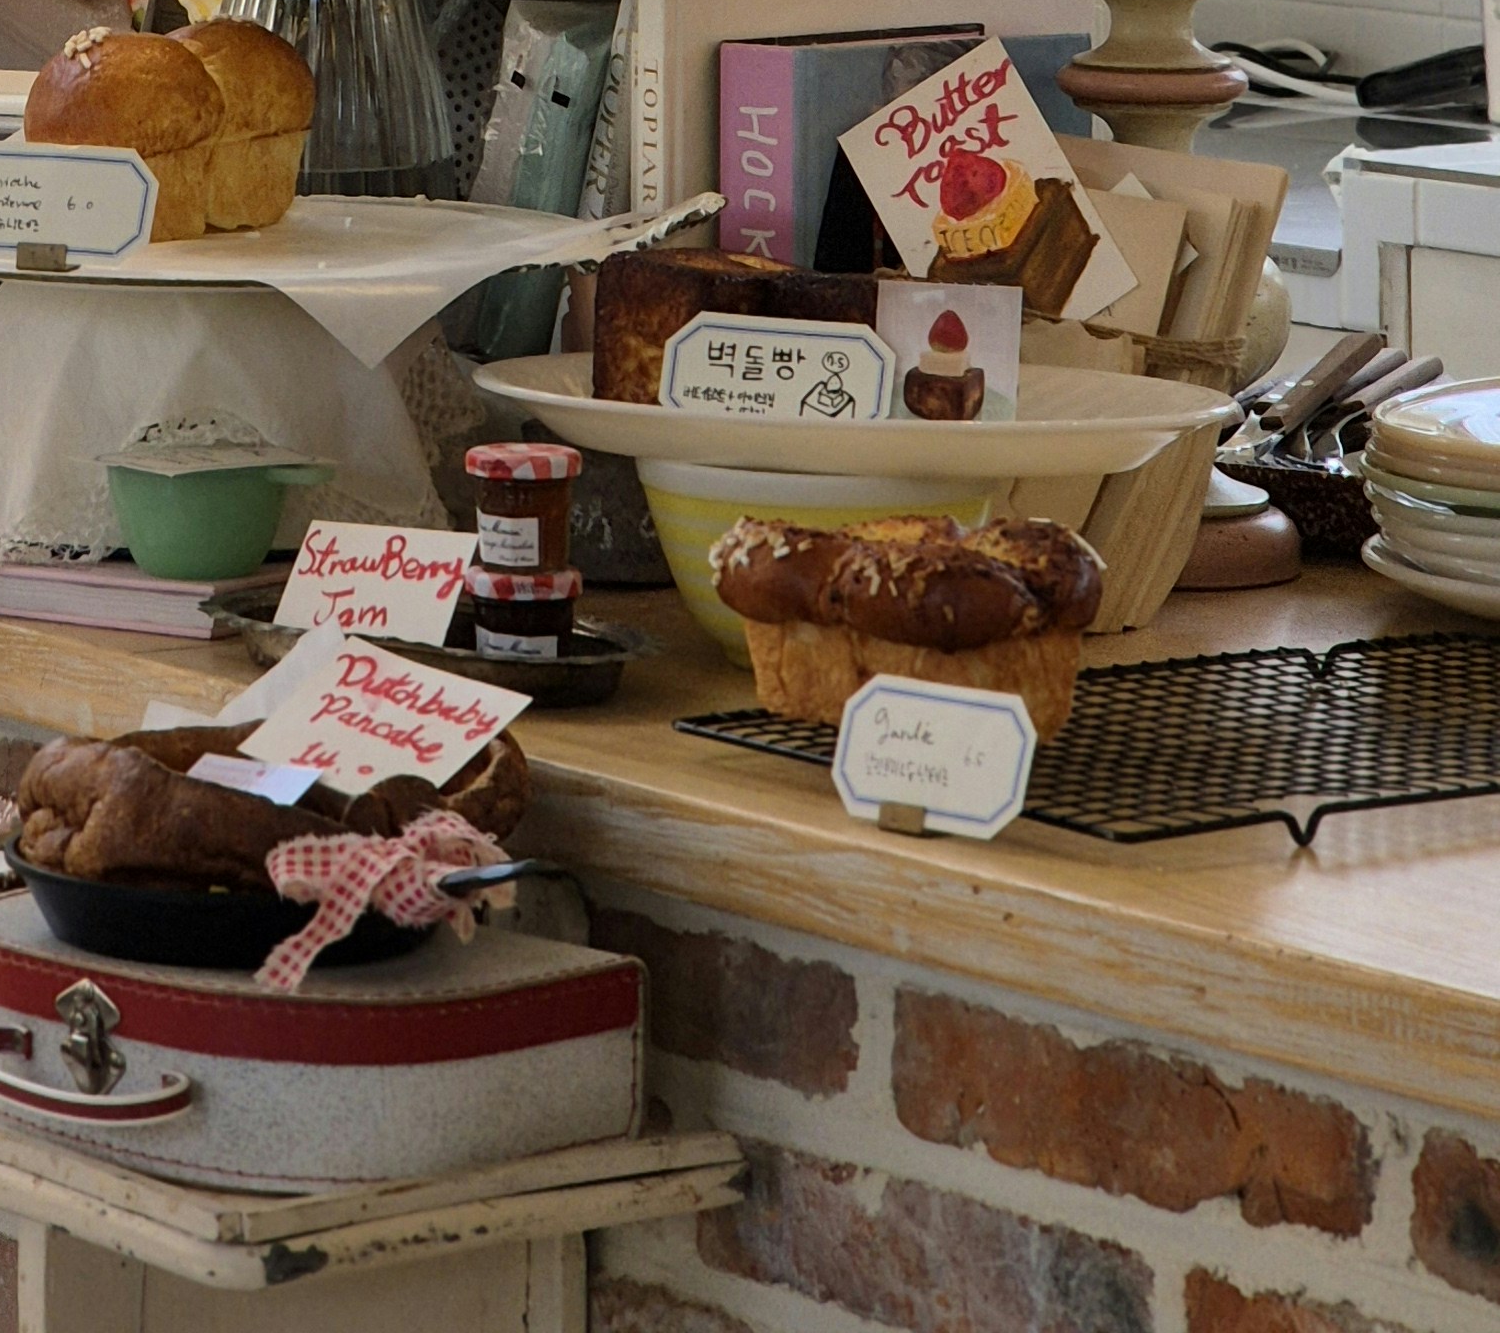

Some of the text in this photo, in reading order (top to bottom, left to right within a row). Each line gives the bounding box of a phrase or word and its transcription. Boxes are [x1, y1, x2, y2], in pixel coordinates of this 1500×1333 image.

[641, 59, 659, 224] TOPIAR
[874, 57, 1012, 159] Butter
[891, 102, 1019, 209] Toast
[707, 340, 807, 382] 벽돌빵
[313, 586, 389, 628] Jam
[310, 692, 444, 764] Pancake
[336, 653, 499, 742] Dutchbaby
